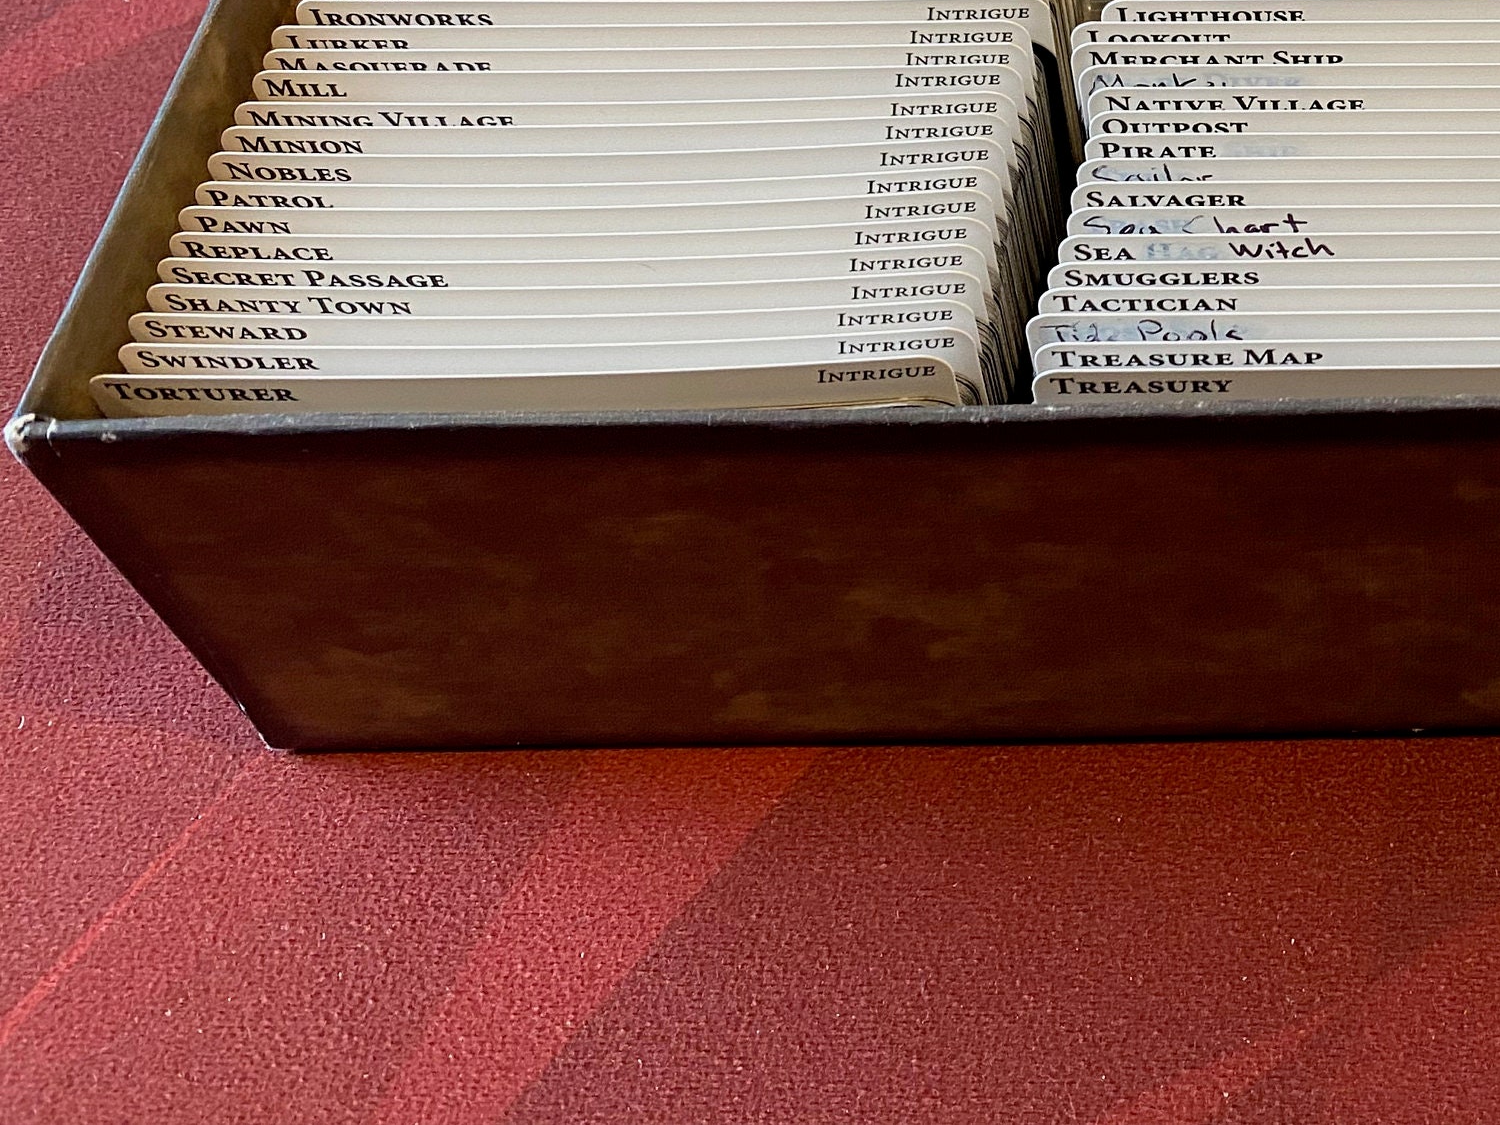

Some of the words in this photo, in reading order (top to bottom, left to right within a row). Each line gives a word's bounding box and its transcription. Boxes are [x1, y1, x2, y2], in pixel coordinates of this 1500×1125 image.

[309, 9, 493, 25] IRONWORKS
[927, 7, 1030, 21] INTRIGUE
[1116, 7, 1305, 22] LIGHTHOUSE
[910, 31, 1012, 44] INTRIGUE
[906, 53, 1010, 65] INTRIGUE
[1273, 51, 1344, 64] SHIP
[263, 79, 347, 97] MILL
[896, 74, 1000, 87] INTRIGUE
[891, 102, 997, 116] INTRIGUE
[1105, 96, 1224, 110] NATIVE
[1233, 96, 1365, 110] VILLAGE
[248, 111, 372, 127] MINING
[378, 111, 515, 127] VILLAGE
[1102, 119, 1248, 133] OUTPOST
[886, 125, 993, 140] INTRIGUE
[236, 136, 364, 154] MINION
[1100, 142, 1216, 158] PIRATE
[880, 150, 988, 166] INTRIGUE
[223, 162, 352, 182] NOBLES
[867, 177, 977, 194] INTRIGUE
[206, 190, 333, 208] PATROL
[1087, 191, 1246, 207] SALVAGER
[865, 202, 976, 219] INTRIGUE
[195, 216, 290, 234] PAWN
[855, 228, 967, 245] INTRIGUE
[181, 241, 333, 261] REPLACE
[1074, 244, 1136, 260] SEA
[1229, 238, 1334, 260] Witch
[850, 256, 963, 272] INTRIGUE
[171, 267, 294, 286] SECRET
[302, 270, 448, 288] PASSAGE
[1065, 270, 1260, 287] SMUGGLERS
[851, 283, 966, 300] INTRIGUE
[165, 295, 301, 313] SHANTY
[309, 297, 412, 315] TOWN
[1053, 295, 1238, 312] TACTICIAN
[838, 310, 953, 327] INTRIGUE
[145, 320, 308, 341] STEWARD
[838, 337, 954, 354] INTRIGUE
[137, 351, 319, 370] SWINDLER
[1052, 350, 1234, 367] TREASURE
[1244, 349, 1324, 365] MAP
[818, 366, 935, 383] INTRIGUE
[104, 383, 299, 402] TORTURER
[1050, 378, 1232, 395] TREASURY
